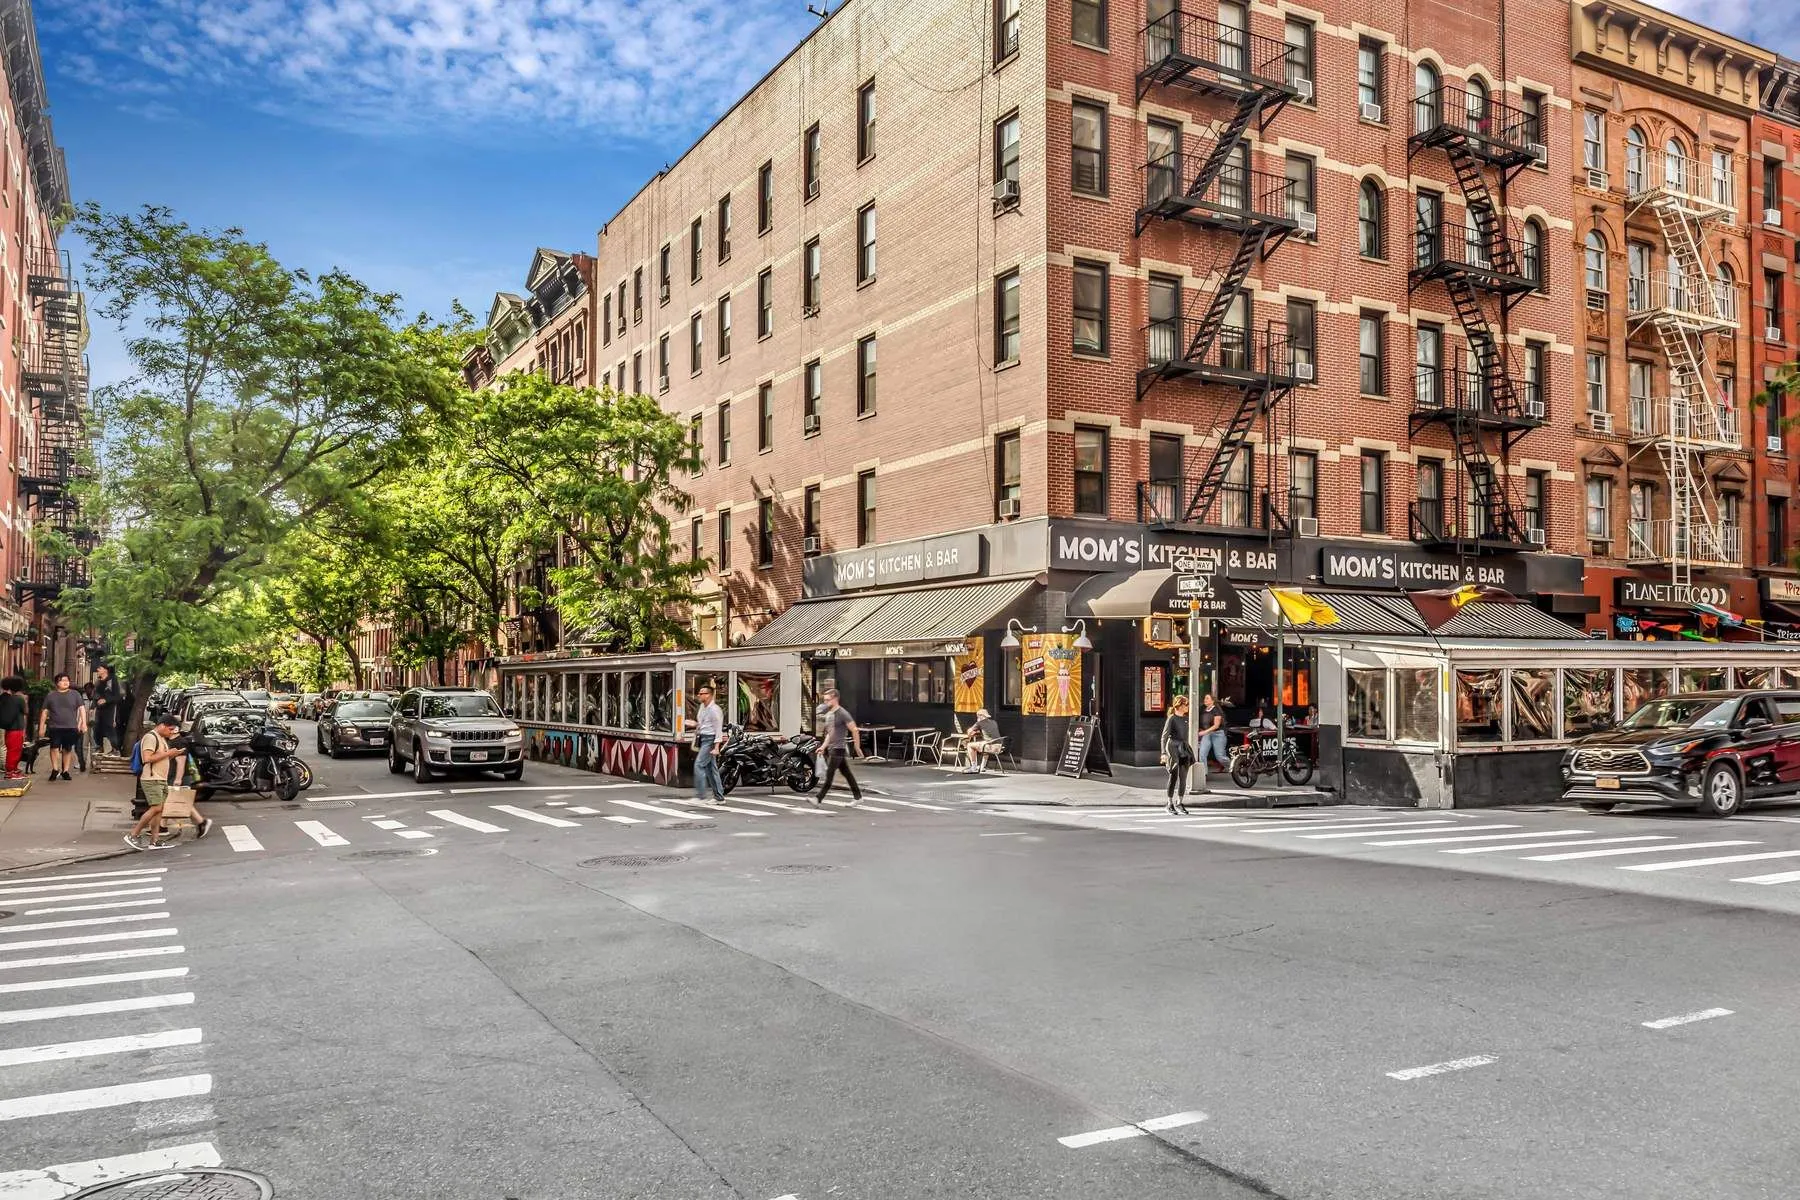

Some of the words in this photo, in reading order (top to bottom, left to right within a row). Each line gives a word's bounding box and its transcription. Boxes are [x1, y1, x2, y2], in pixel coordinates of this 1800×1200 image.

[1059, 536, 1140, 563] MOM'S
[1229, 550, 1241, 567] &
[1246, 552, 1276, 570] BAR
[837, 558, 875, 582] MOM'S
[879, 554, 921, 575] KITCHEN
[925, 552, 933, 568] &
[937, 548, 958, 566] BAR
[1330, 555, 1394, 579] MOM'S
[1400, 562, 1459, 581] KITCHEN
[1465, 566, 1474, 582] &
[1479, 567, 1504, 583] BAR
[1625, 582, 1672, 602] PLANET
[1203, 600, 1209, 609] &
[1211, 600, 1226, 609] BAR
[1230, 633, 1258, 642] MOM'S
[886, 647, 904, 655] MOM'S
